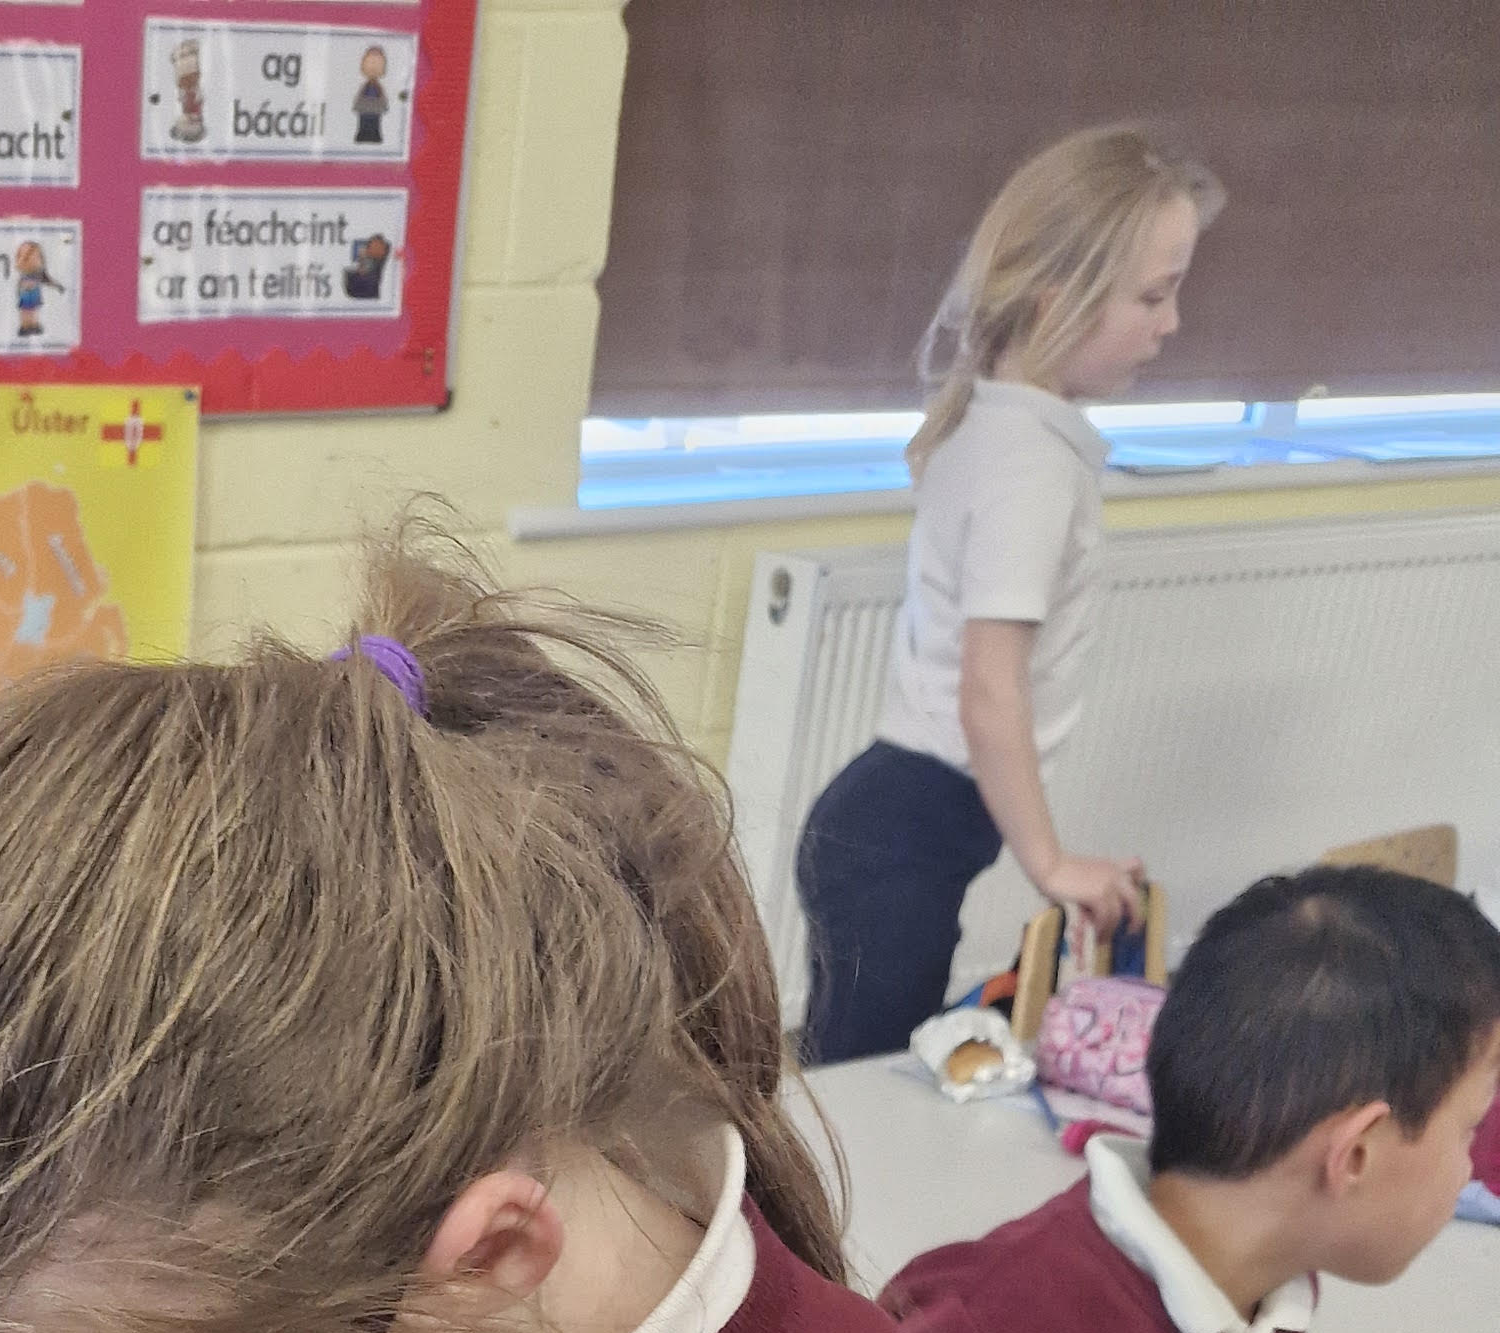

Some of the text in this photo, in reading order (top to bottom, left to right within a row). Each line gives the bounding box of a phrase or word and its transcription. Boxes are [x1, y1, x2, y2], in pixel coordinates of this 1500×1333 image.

[262, 52, 301, 86] ag
[234, 98, 326, 137] bácáil
[153, 220, 192, 251] ag
[198, 274, 238, 300] an
